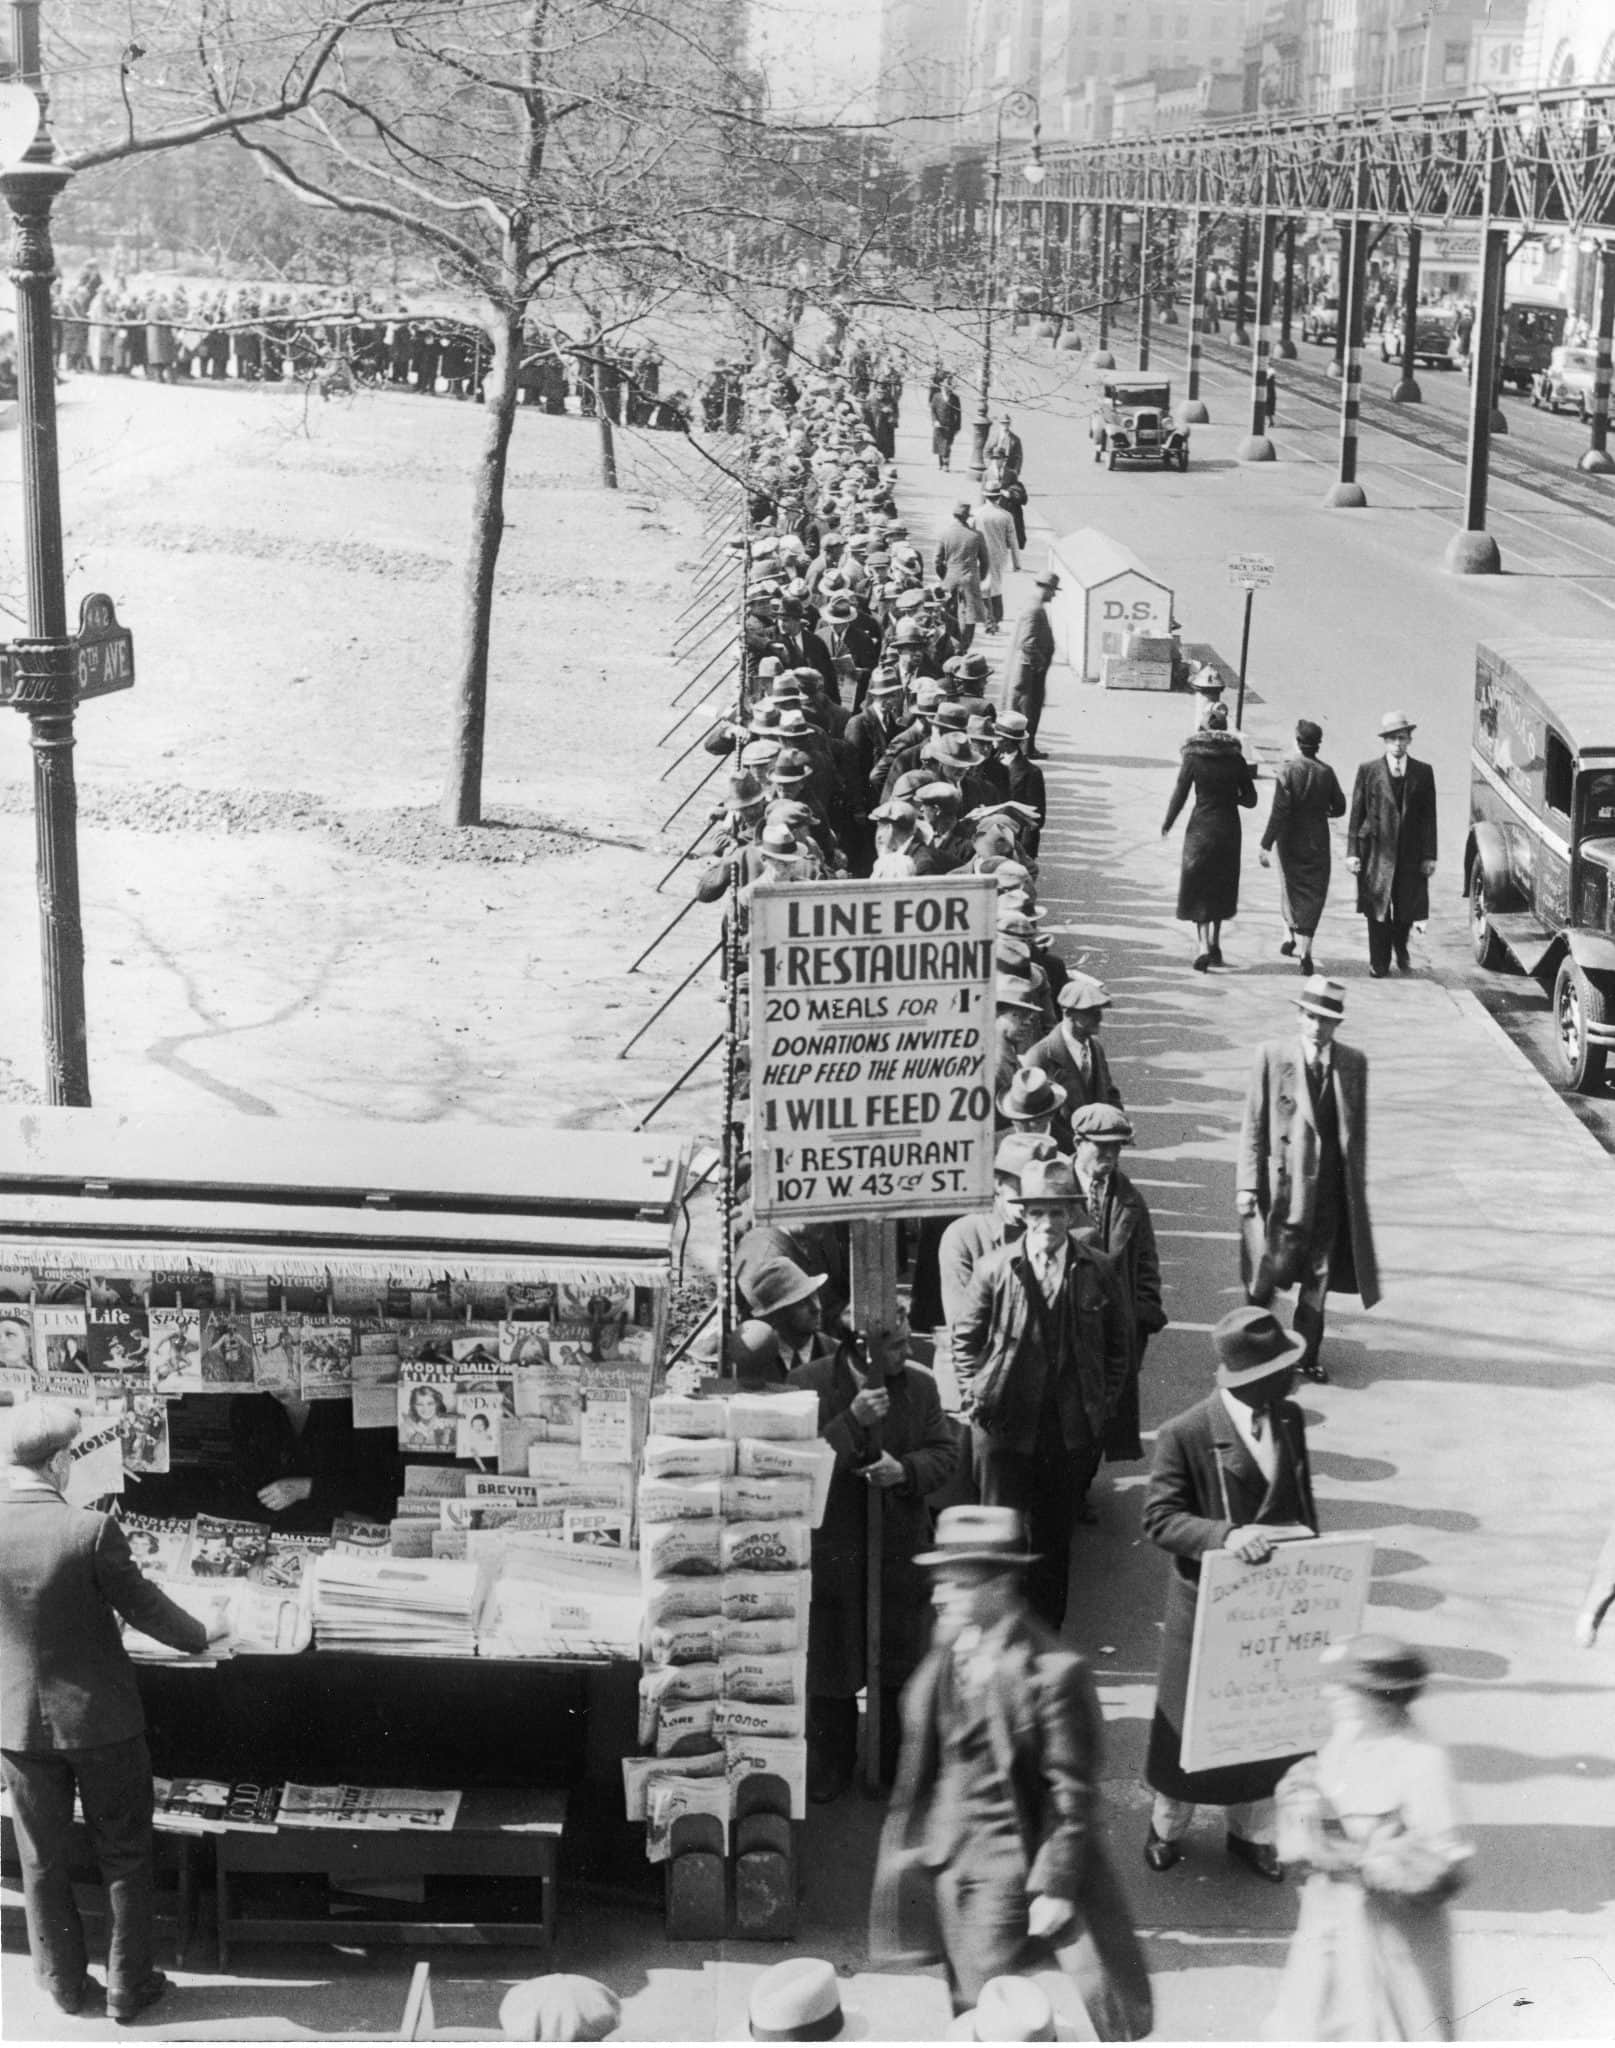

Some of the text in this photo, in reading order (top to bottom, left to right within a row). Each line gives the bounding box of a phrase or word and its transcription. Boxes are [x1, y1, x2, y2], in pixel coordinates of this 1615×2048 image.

[1103, 601, 1158, 621] D.S.
[103, 640, 130, 681] AVE
[788, 897, 970, 938] LINE FOR
[788, 939, 994, 986] RESTAURANT
[765, 998, 801, 1023] 20
[808, 996, 888, 1021] MEALS
[898, 998, 938, 1016] FOR
[771, 1028, 979, 1057] DONATIONS INVITED
[762, 1054, 986, 1086] HELP FEED THE HUNGRY
[786, 1097, 858, 1131] WILL
[866, 1092, 941, 1127] FEED
[948, 1086, 992, 1122] 20
[801, 1139, 974, 1172] RESTAURANT
[777, 1177, 818, 1202] 107
[860, 1172, 924, 1195] 43rd
[931, 1169, 968, 1193] ST.
[90, 1307, 130, 1325] Life
[400, 1362, 455, 1374] MODER
[403, 1372, 454, 1383] LIVIN
[125, 1510, 190, 1529] MODERN
[125, 1519, 184, 1534] LIVING
[569, 1515, 606, 1529] PEP
[1239, 1631, 1331, 1658] HOT MEAL
